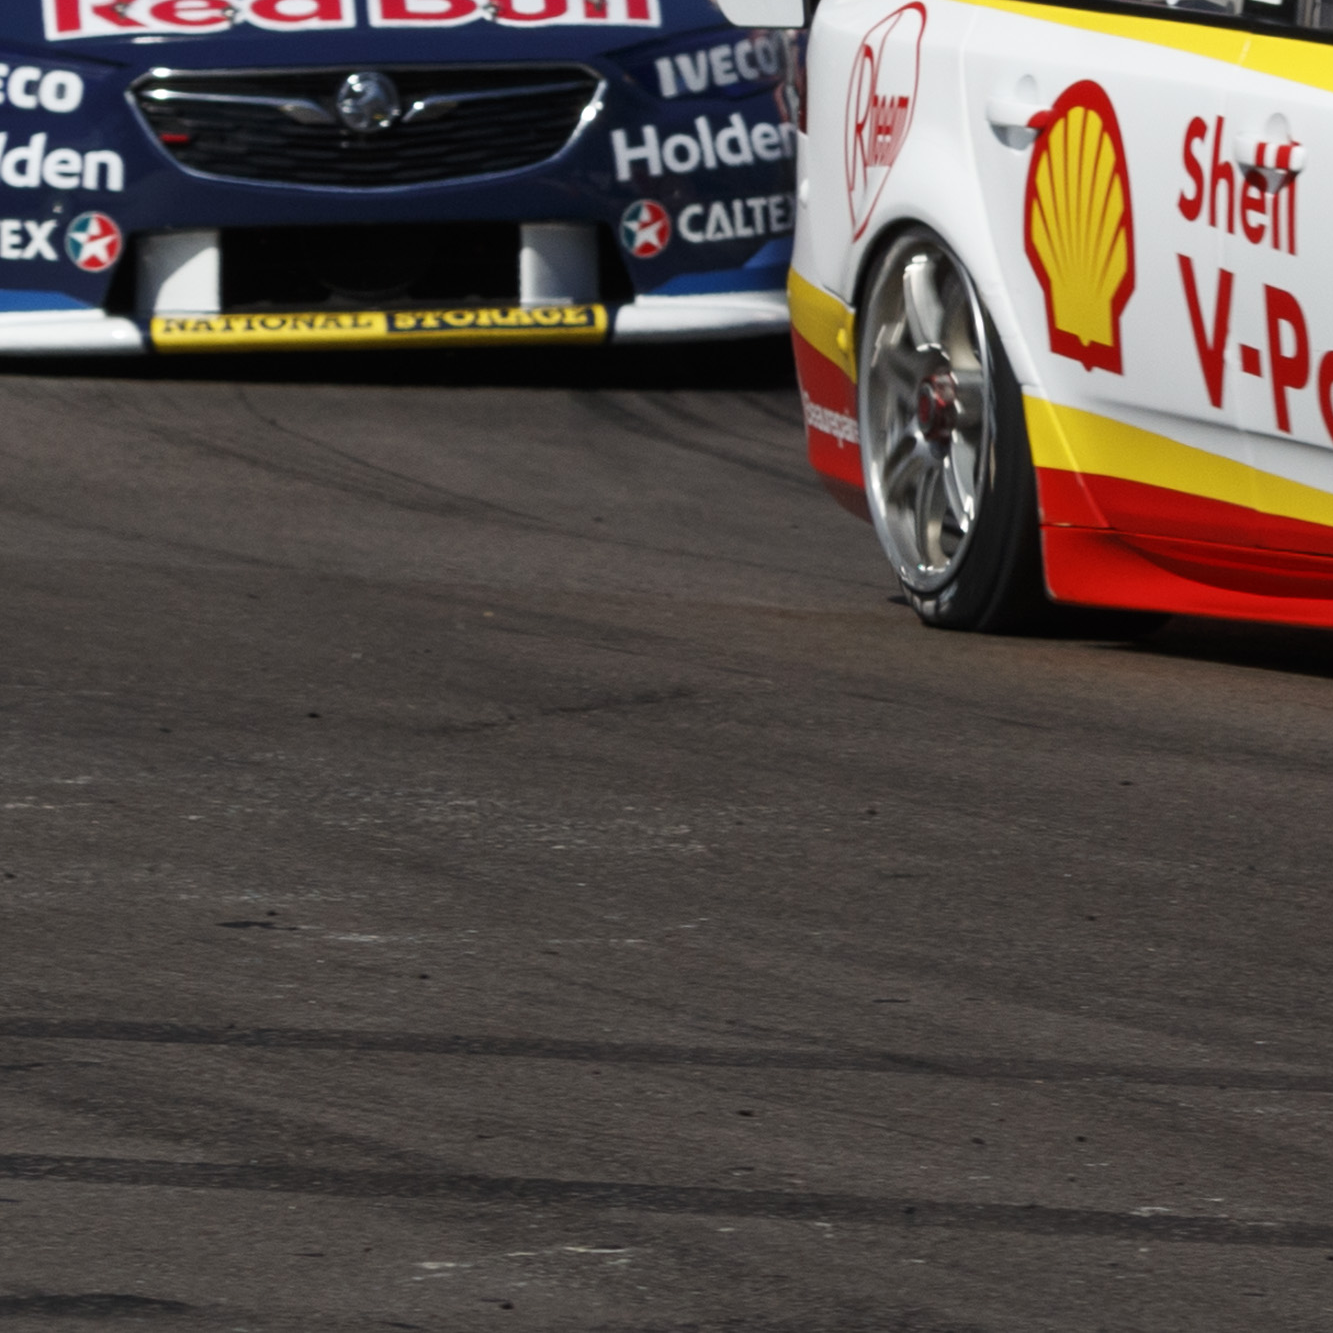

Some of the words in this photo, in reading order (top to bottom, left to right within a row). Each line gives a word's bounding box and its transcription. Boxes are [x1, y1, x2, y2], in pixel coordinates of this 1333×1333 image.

[655, 36, 779, 98] IVECO
[1177, 115, 1297, 256] Shell
[678, 195, 798, 244] CALTE
[163, 314, 374, 335] NATIONAL
[393, 307, 590, 330] STORAGE
